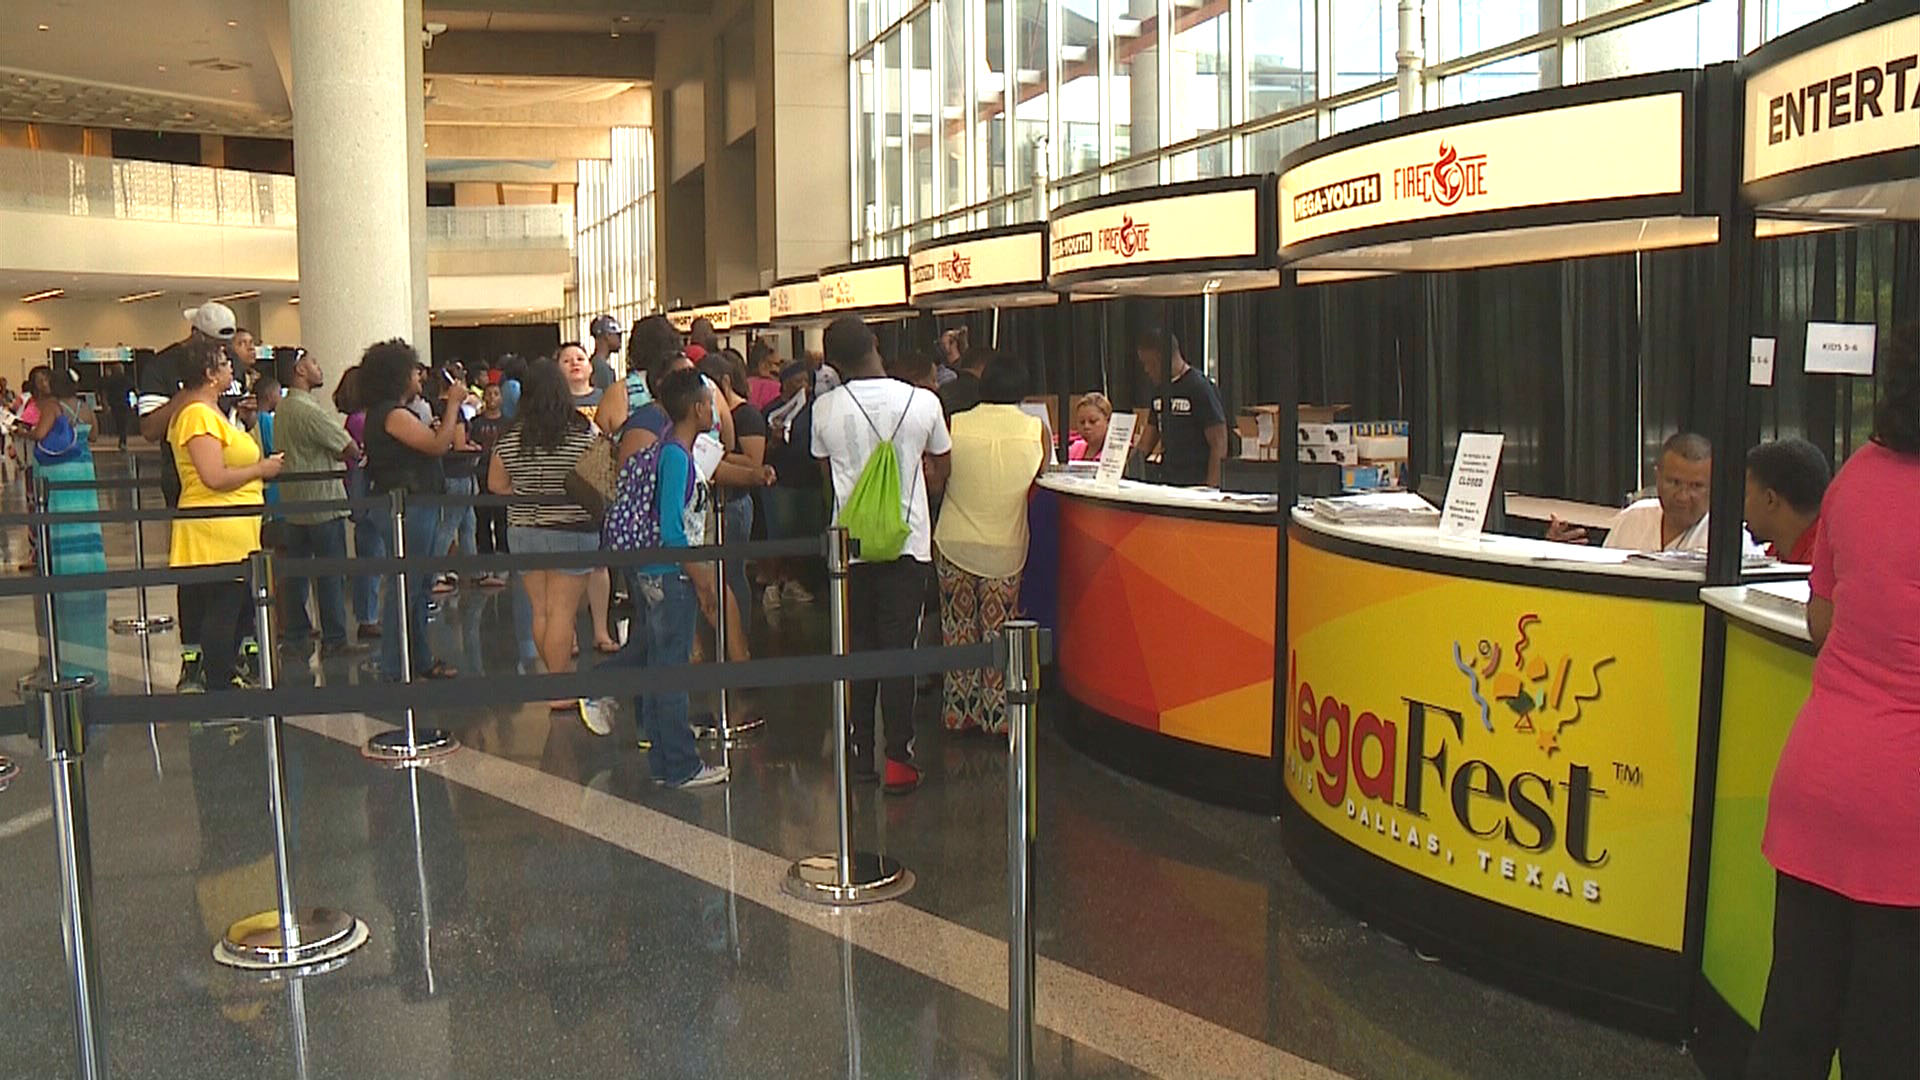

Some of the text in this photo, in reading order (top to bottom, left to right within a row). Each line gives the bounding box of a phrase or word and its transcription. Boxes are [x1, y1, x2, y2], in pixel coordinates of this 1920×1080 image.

[1294, 174, 1381, 222] MEGA-YOUTH
[1347, 798, 1454, 864] DALLAS,
[1478, 850, 1601, 902] TEXAS
